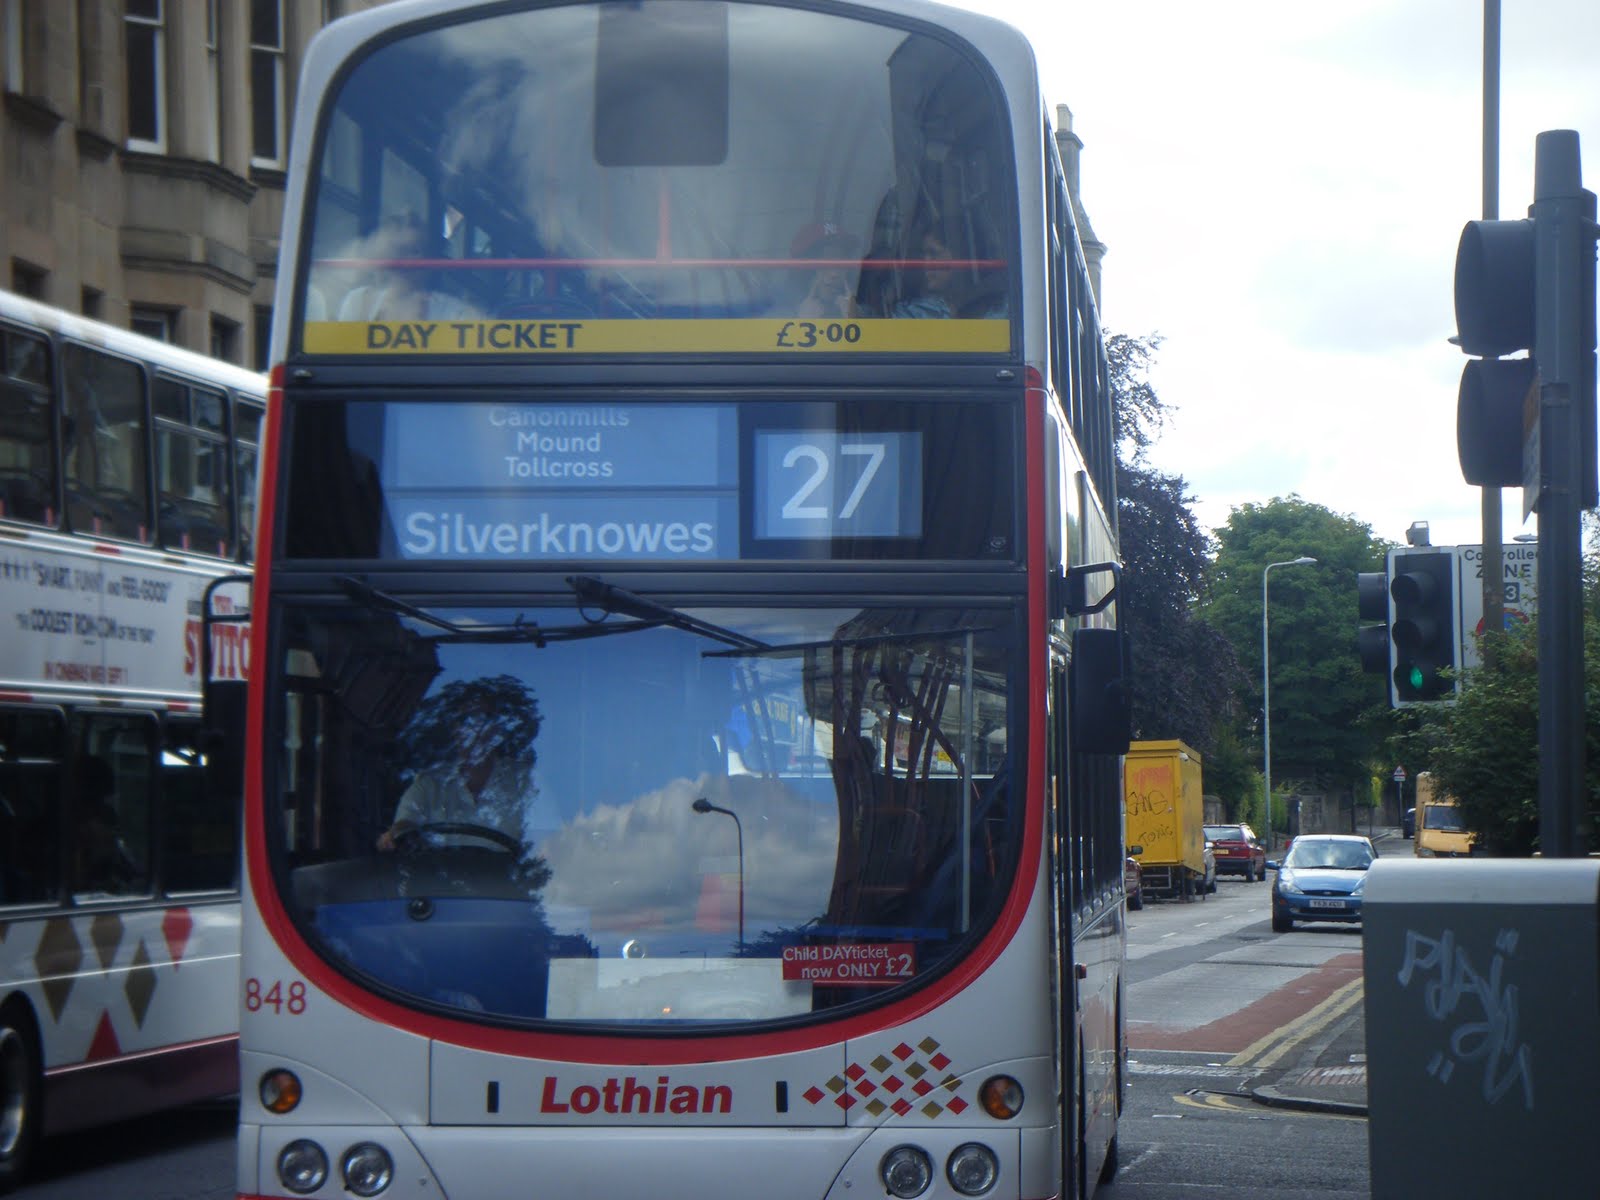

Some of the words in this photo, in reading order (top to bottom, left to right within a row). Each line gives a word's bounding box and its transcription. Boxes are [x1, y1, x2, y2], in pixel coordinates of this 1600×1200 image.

[366, 323, 437, 349] DAY
[451, 323, 583, 349] TICKET
[488, 406, 630, 427] Canonmills
[517, 431, 601, 453] Mound
[505, 456, 614, 478] Tollcross
[782, 444, 886, 519] 27
[404, 511, 715, 554] Silverknowes
[1464, 548, 1537, 561] Corolle
[1475, 563, 1532, 578] ZNE
[783, 946, 819, 961] Child
[823, 945, 889, 960] DAYticket
[801, 967, 833, 979] now
[837, 962, 880, 977] ONLY
[885, 953, 914, 977] £2
[246, 978, 307, 1015] 848
[540, 1076, 733, 1114] Lothian
